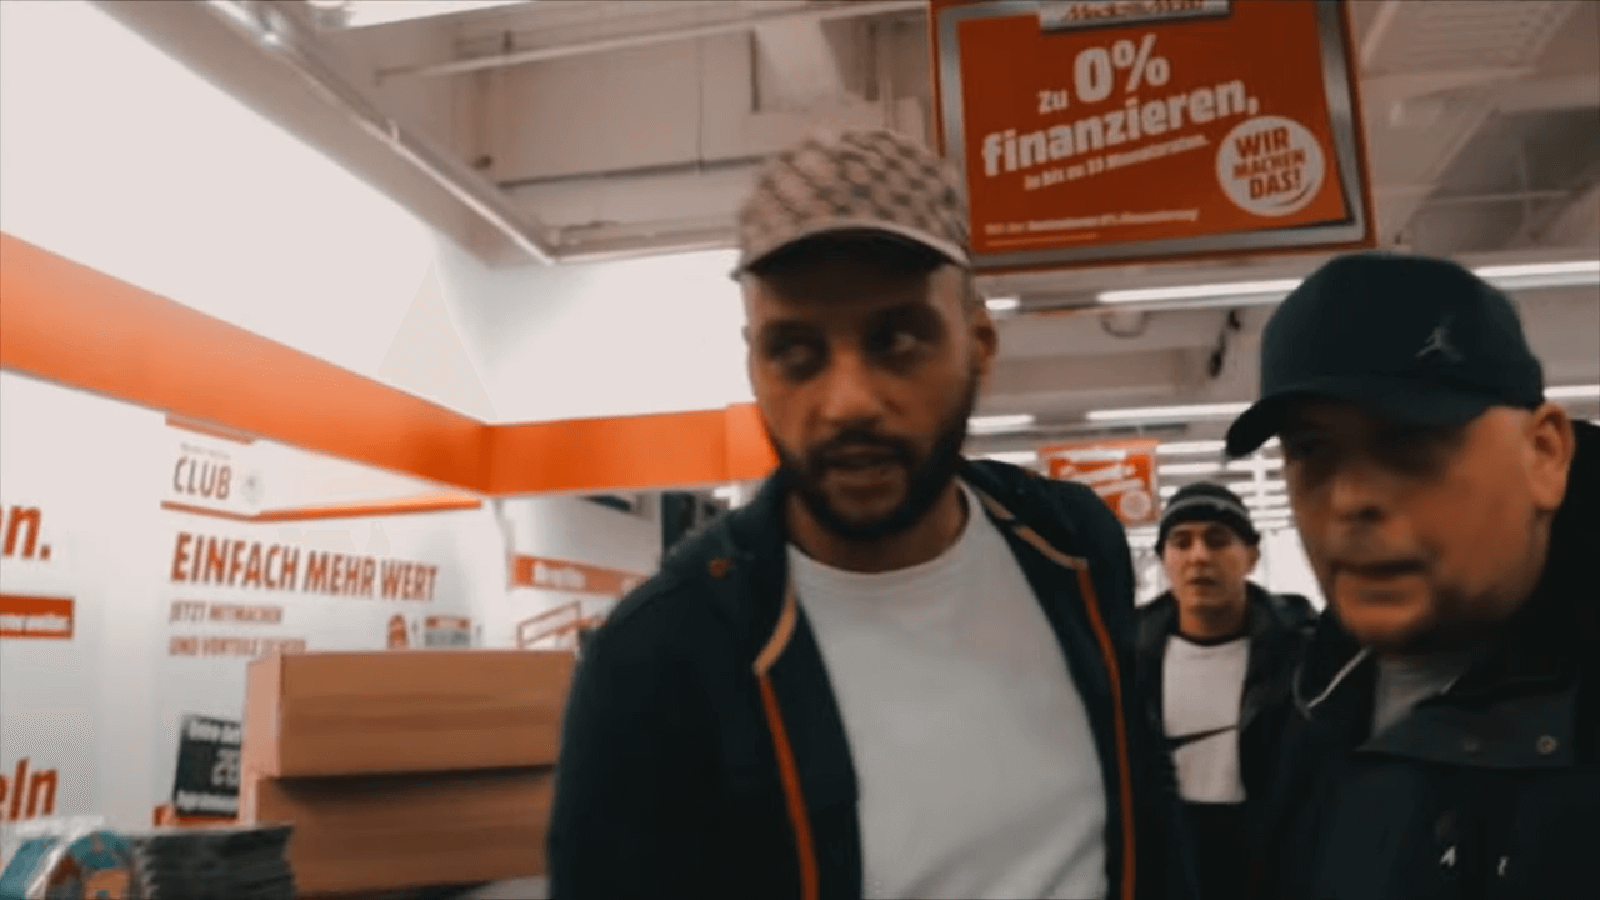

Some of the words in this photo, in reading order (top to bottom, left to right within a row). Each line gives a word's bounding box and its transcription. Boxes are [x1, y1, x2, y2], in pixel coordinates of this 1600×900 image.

[1074, 33, 1170, 103] 0%
[983, 80, 1260, 177] finanzieren,
[1234, 126, 1289, 158] WIR
[1233, 148, 1306, 180] MACHEN
[1249, 166, 1301, 200] DAS!
[173, 456, 232, 500] CLUB
[170, 531, 300, 592] EINFACH
[302, 549, 376, 598] MEHR
[378, 558, 438, 602] WERT
